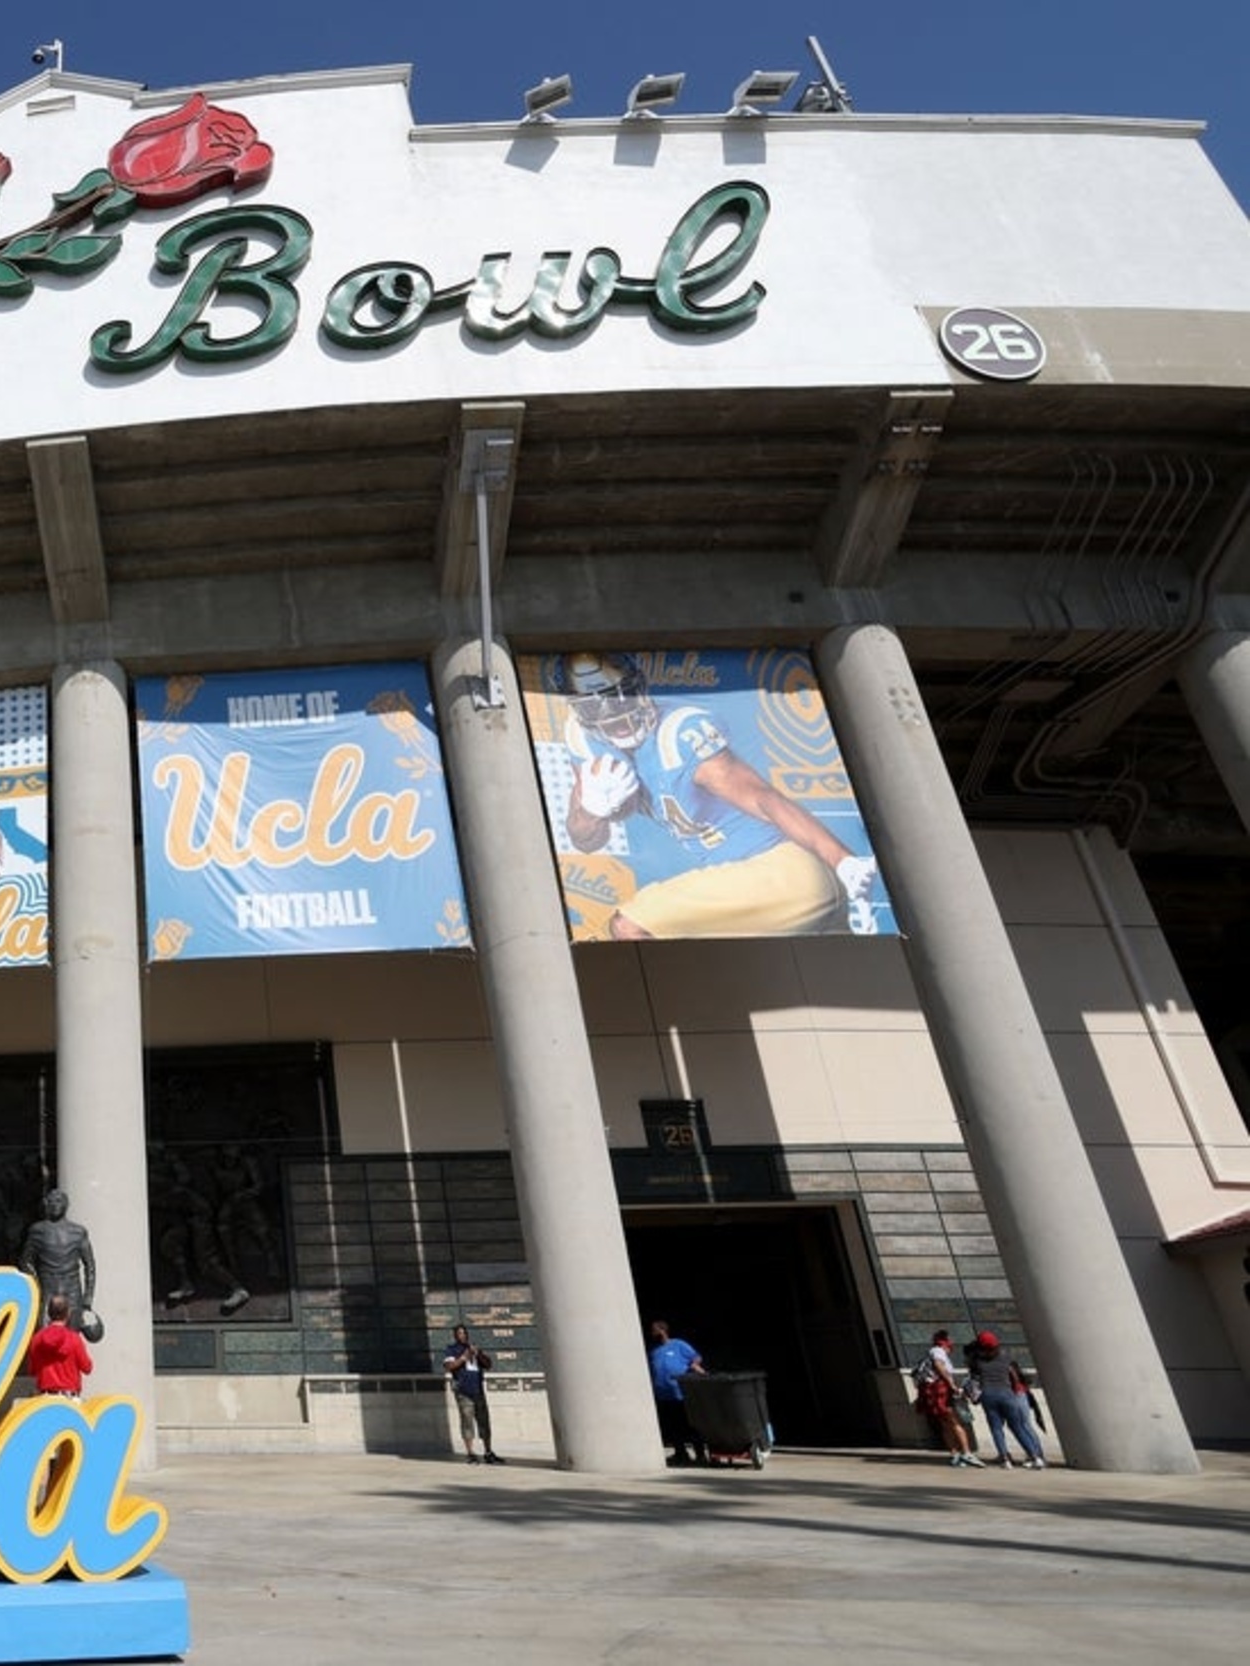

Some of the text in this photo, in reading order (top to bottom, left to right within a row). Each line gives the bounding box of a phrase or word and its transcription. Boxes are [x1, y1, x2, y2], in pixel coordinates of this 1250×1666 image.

[90, 179, 771, 374] Bowl
[951, 324, 1037, 360] 26
[227, 690, 339, 728] HOME OF
[153, 743, 436, 871] Ucla
[236, 888, 378, 929] FOOTBALL
